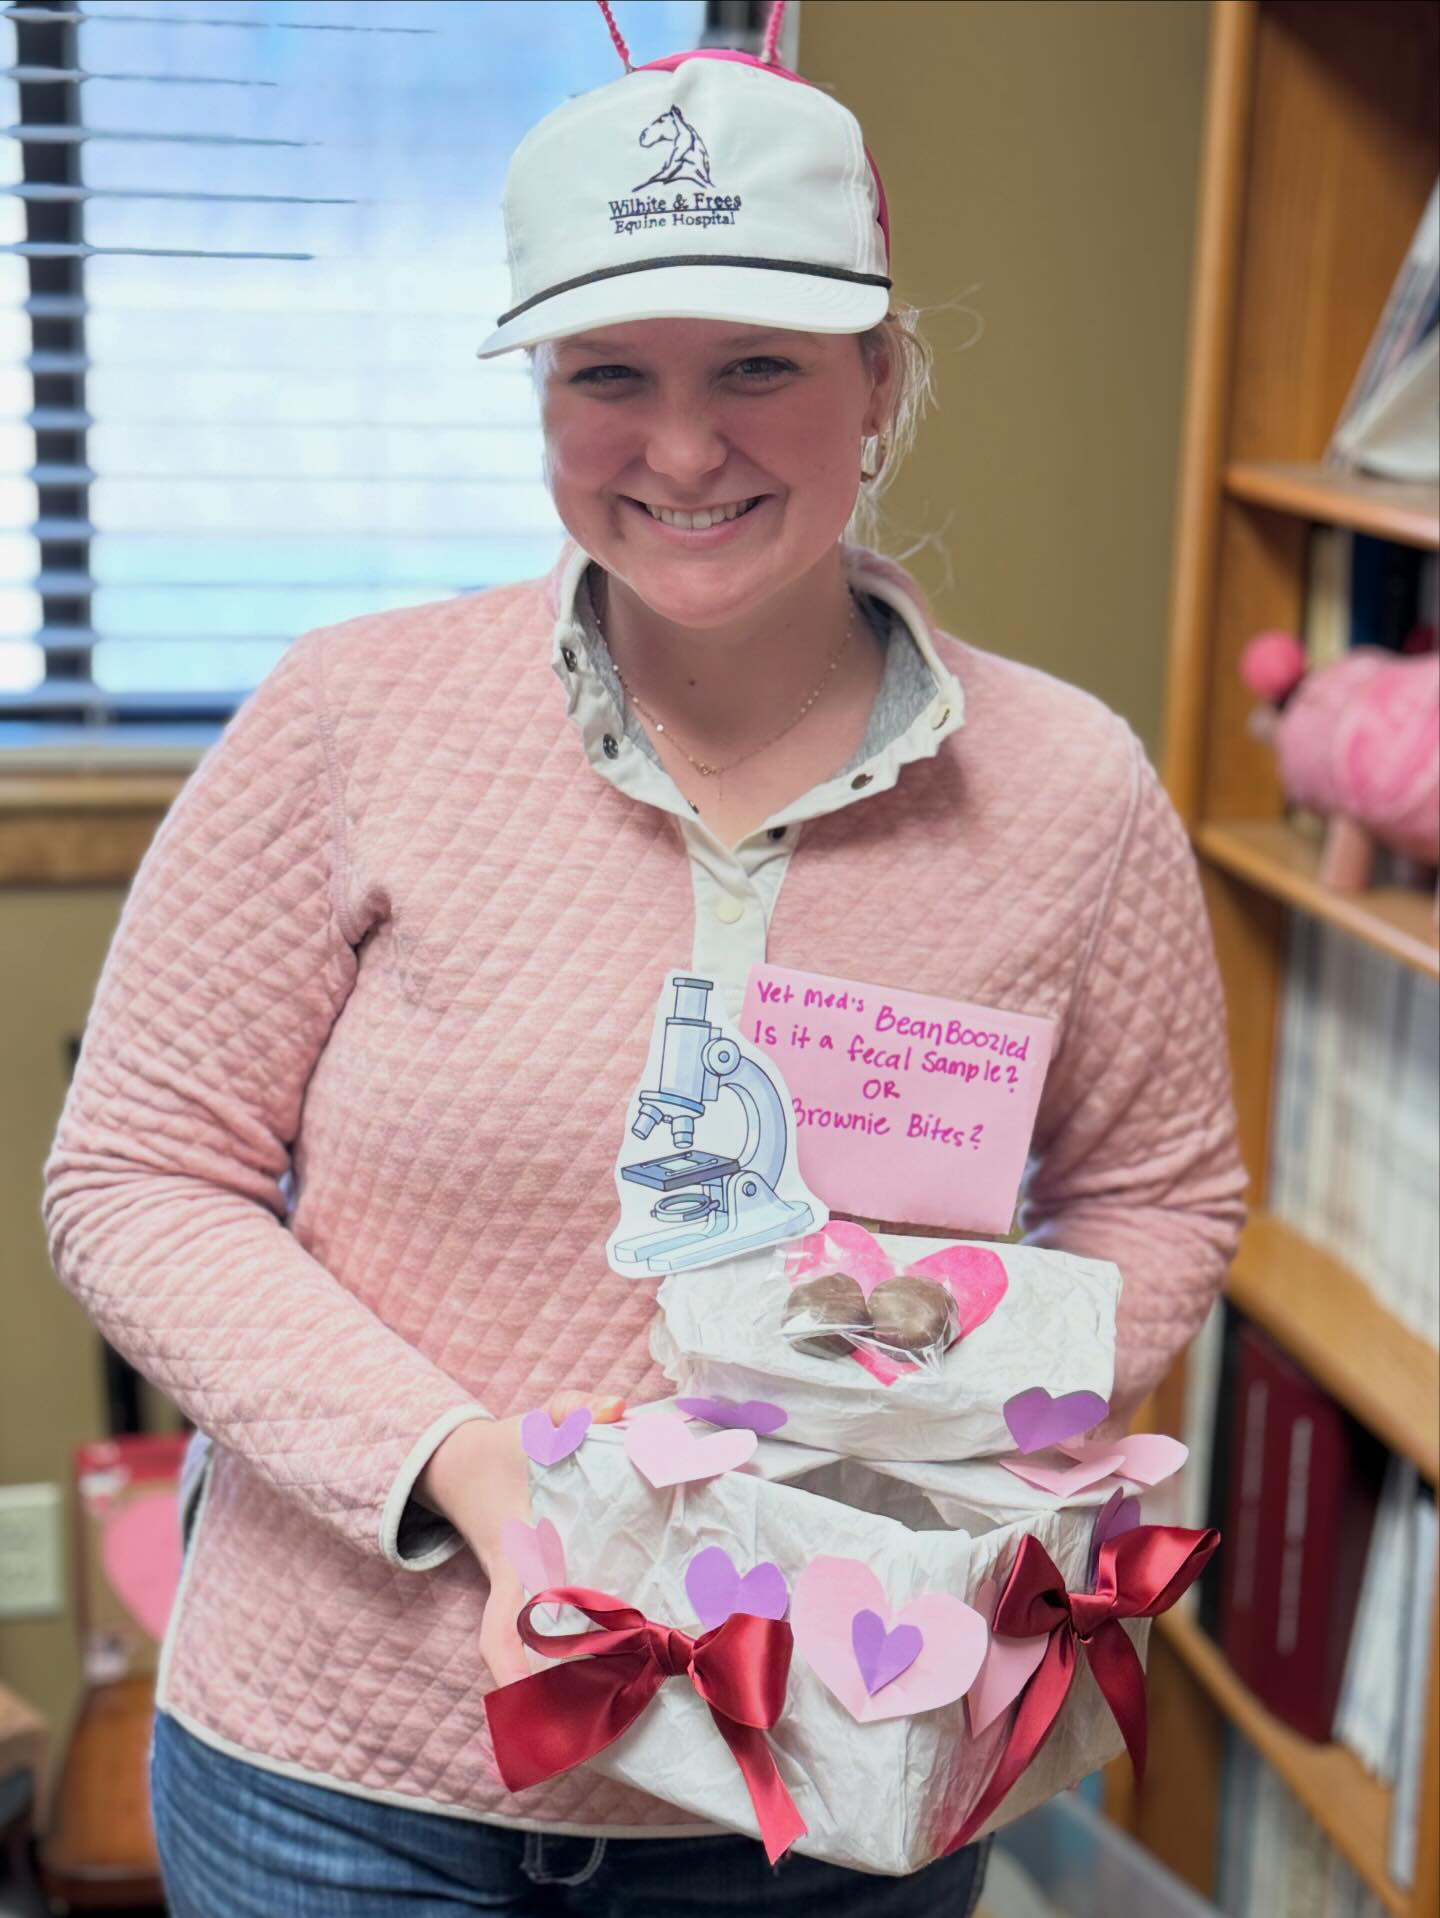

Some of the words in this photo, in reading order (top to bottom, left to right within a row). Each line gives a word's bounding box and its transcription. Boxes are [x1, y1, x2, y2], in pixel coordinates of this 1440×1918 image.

[608, 196, 667, 217] Wilhite
[673, 193, 689, 210] &
[694, 193, 742, 210] Frees
[614, 213, 666, 235] Equine
[672, 211, 735, 228] Hospital
[757, 980, 794, 1003] Vet
[875, 1005, 1030, 1061] BeanBoozled
[754, 1020, 777, 1045] Is
[791, 1024, 811, 1049] it
[819, 1035, 834, 1050] a
[848, 1034, 912, 1071] fecal
[862, 1079, 901, 1100] OR
[792, 1097, 891, 1136] Brownie
[906, 1113, 984, 1150] Bites?
